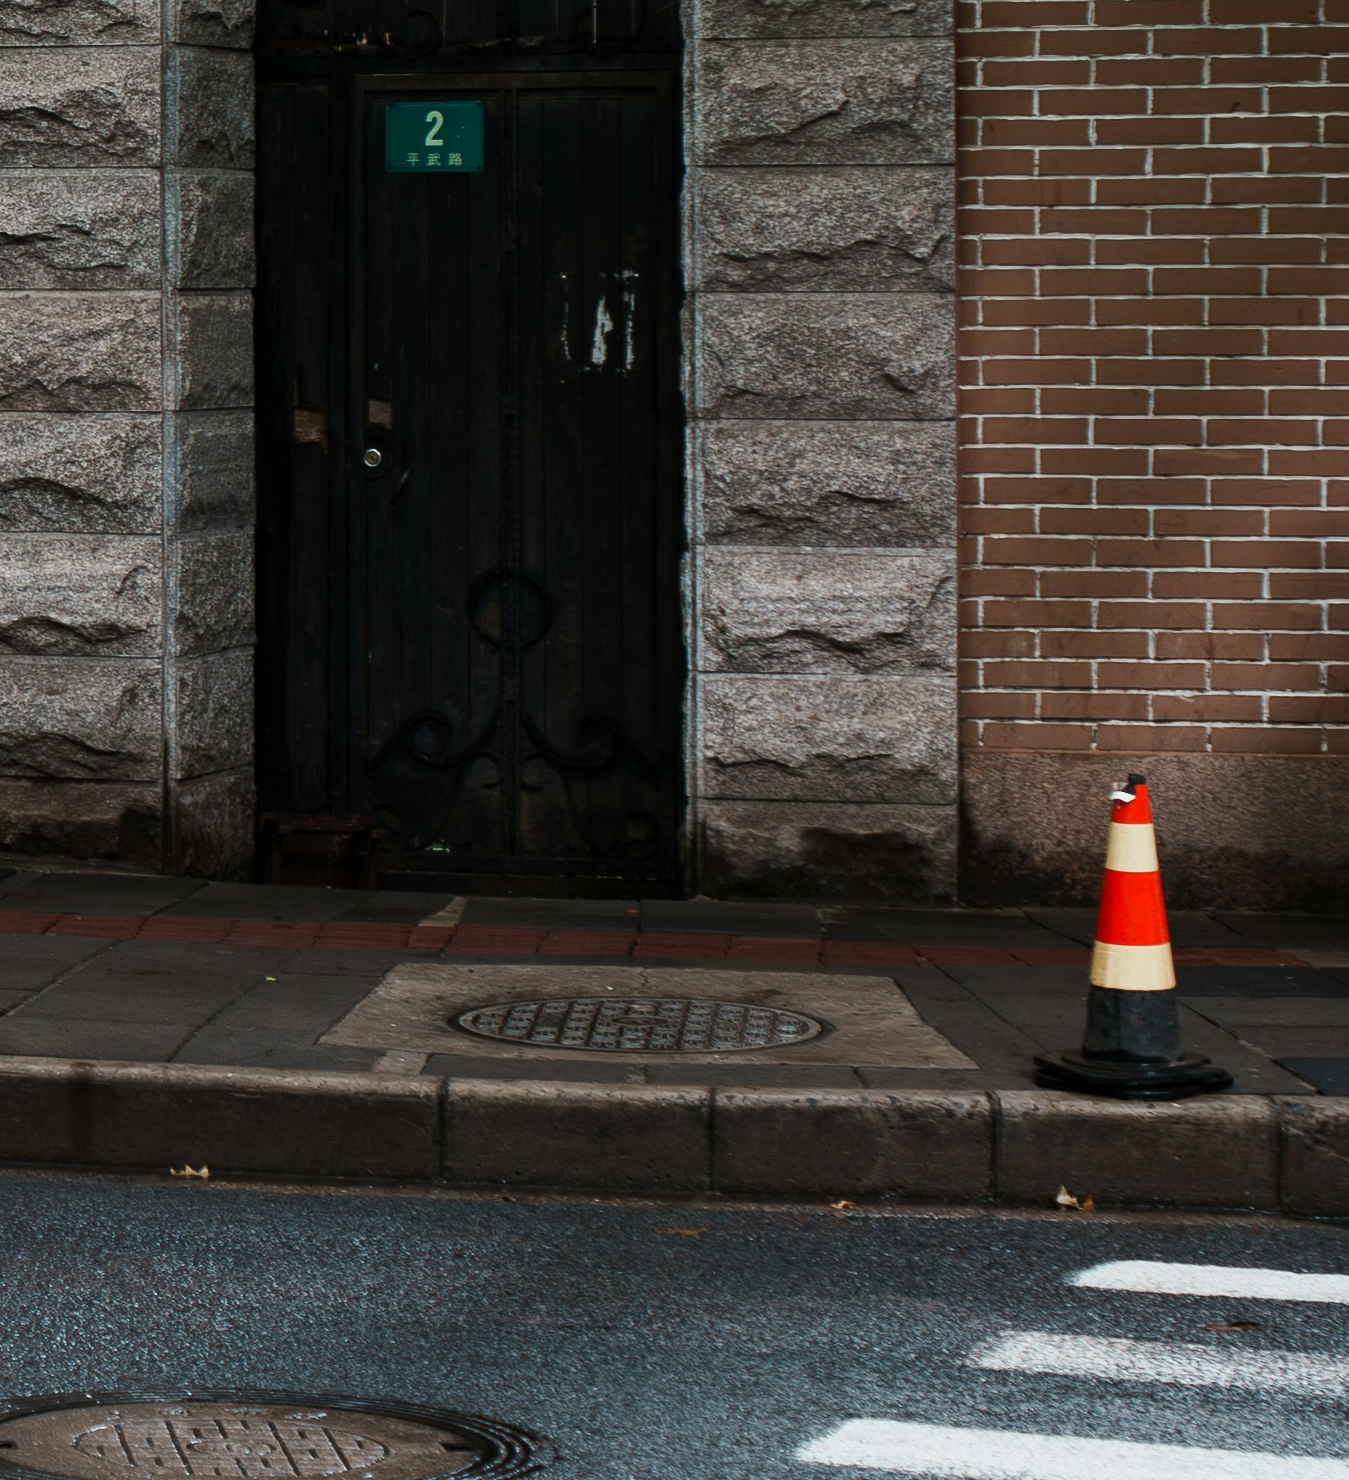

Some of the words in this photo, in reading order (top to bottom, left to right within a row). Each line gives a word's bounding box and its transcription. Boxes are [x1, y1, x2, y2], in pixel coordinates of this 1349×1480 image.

[425, 110, 444, 146] 2
[406, 152, 462, 166] 平武路
